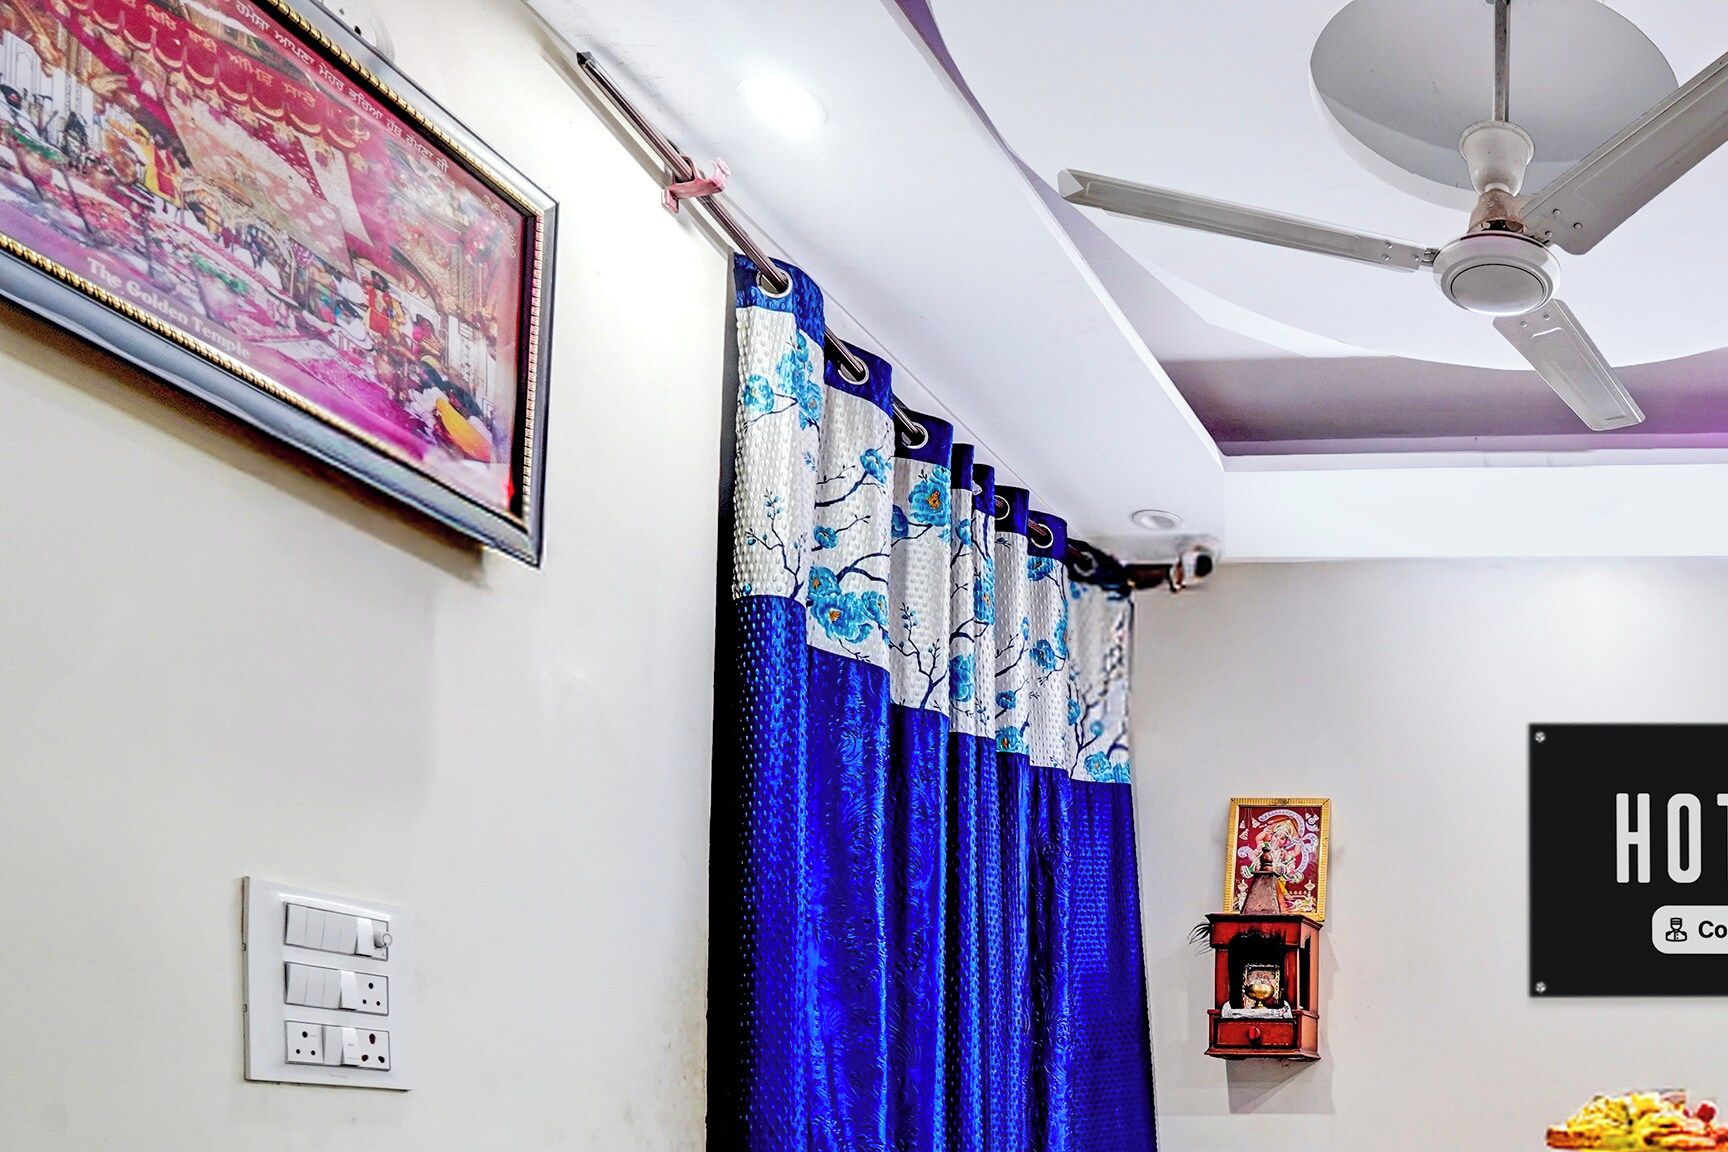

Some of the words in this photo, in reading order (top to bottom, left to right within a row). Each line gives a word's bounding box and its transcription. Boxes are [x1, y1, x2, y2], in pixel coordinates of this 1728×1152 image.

[87, 256, 122, 288] The
[126, 280, 188, 325] Golden
[192, 316, 251, 359] Temple
